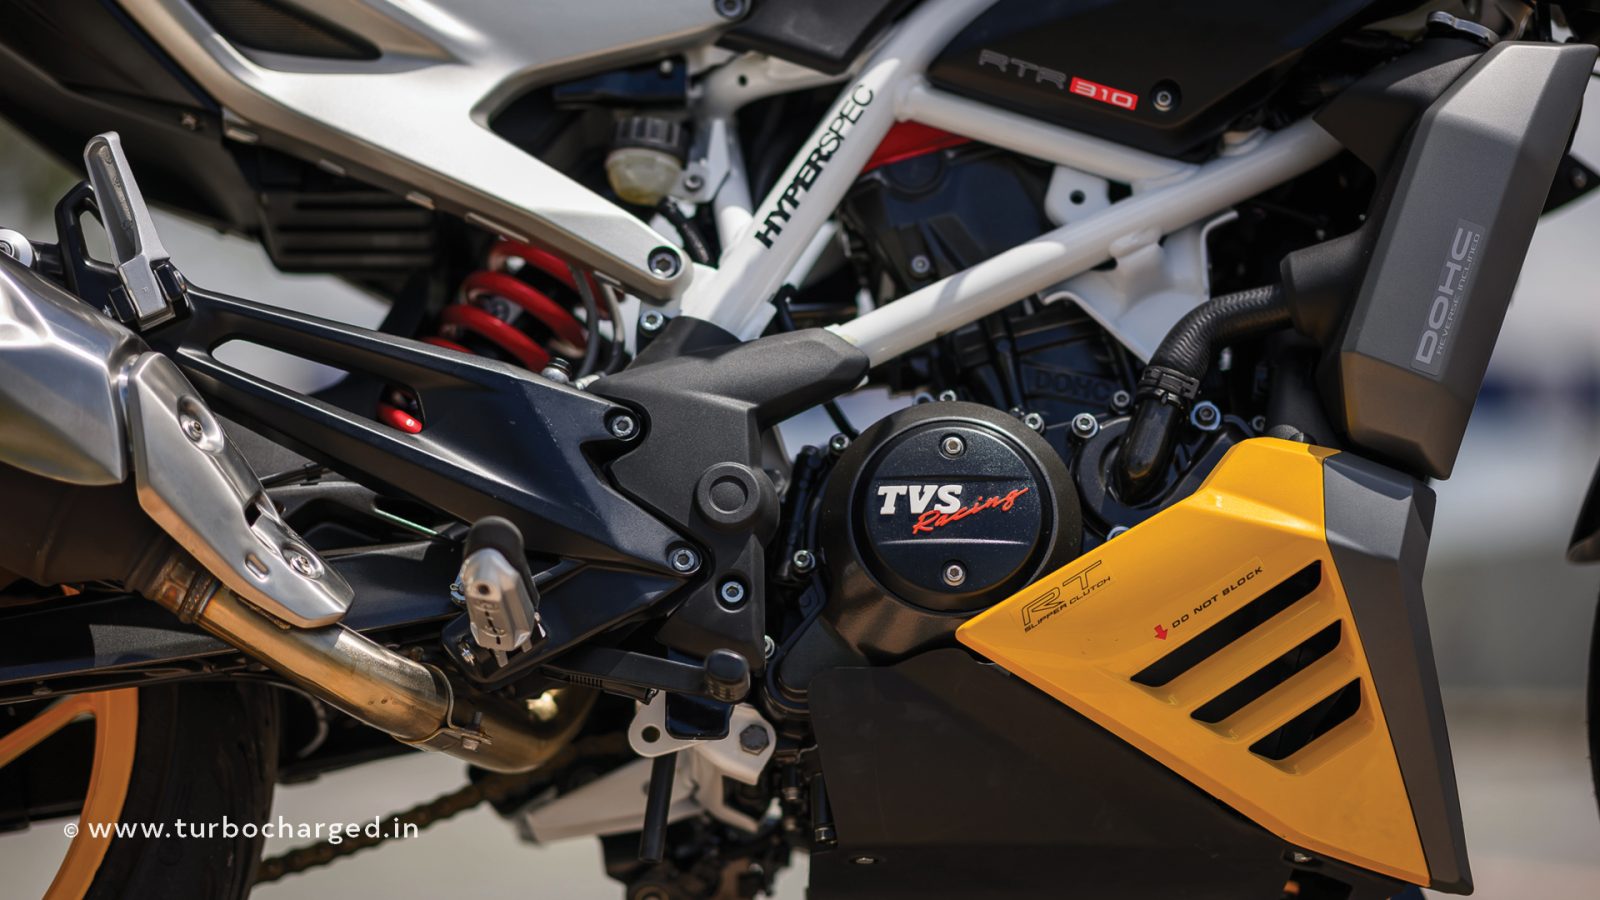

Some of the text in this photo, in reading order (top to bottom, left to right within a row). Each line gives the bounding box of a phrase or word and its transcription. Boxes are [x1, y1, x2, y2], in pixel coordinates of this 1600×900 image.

[979, 49, 1133, 108] RTR 310
[754, 84, 873, 249] HYPERSPEC
[1416, 228, 1473, 363] DOHC
[1437, 234, 1480, 354] REVERSE INCLINED
[878, 485, 1029, 534] TVS Racing
[1021, 559, 1102, 626] RT
[1024, 576, 1111, 633] SLIPPER CLUTCH
[1172, 566, 1263, 628] DO NOT BLOCK
